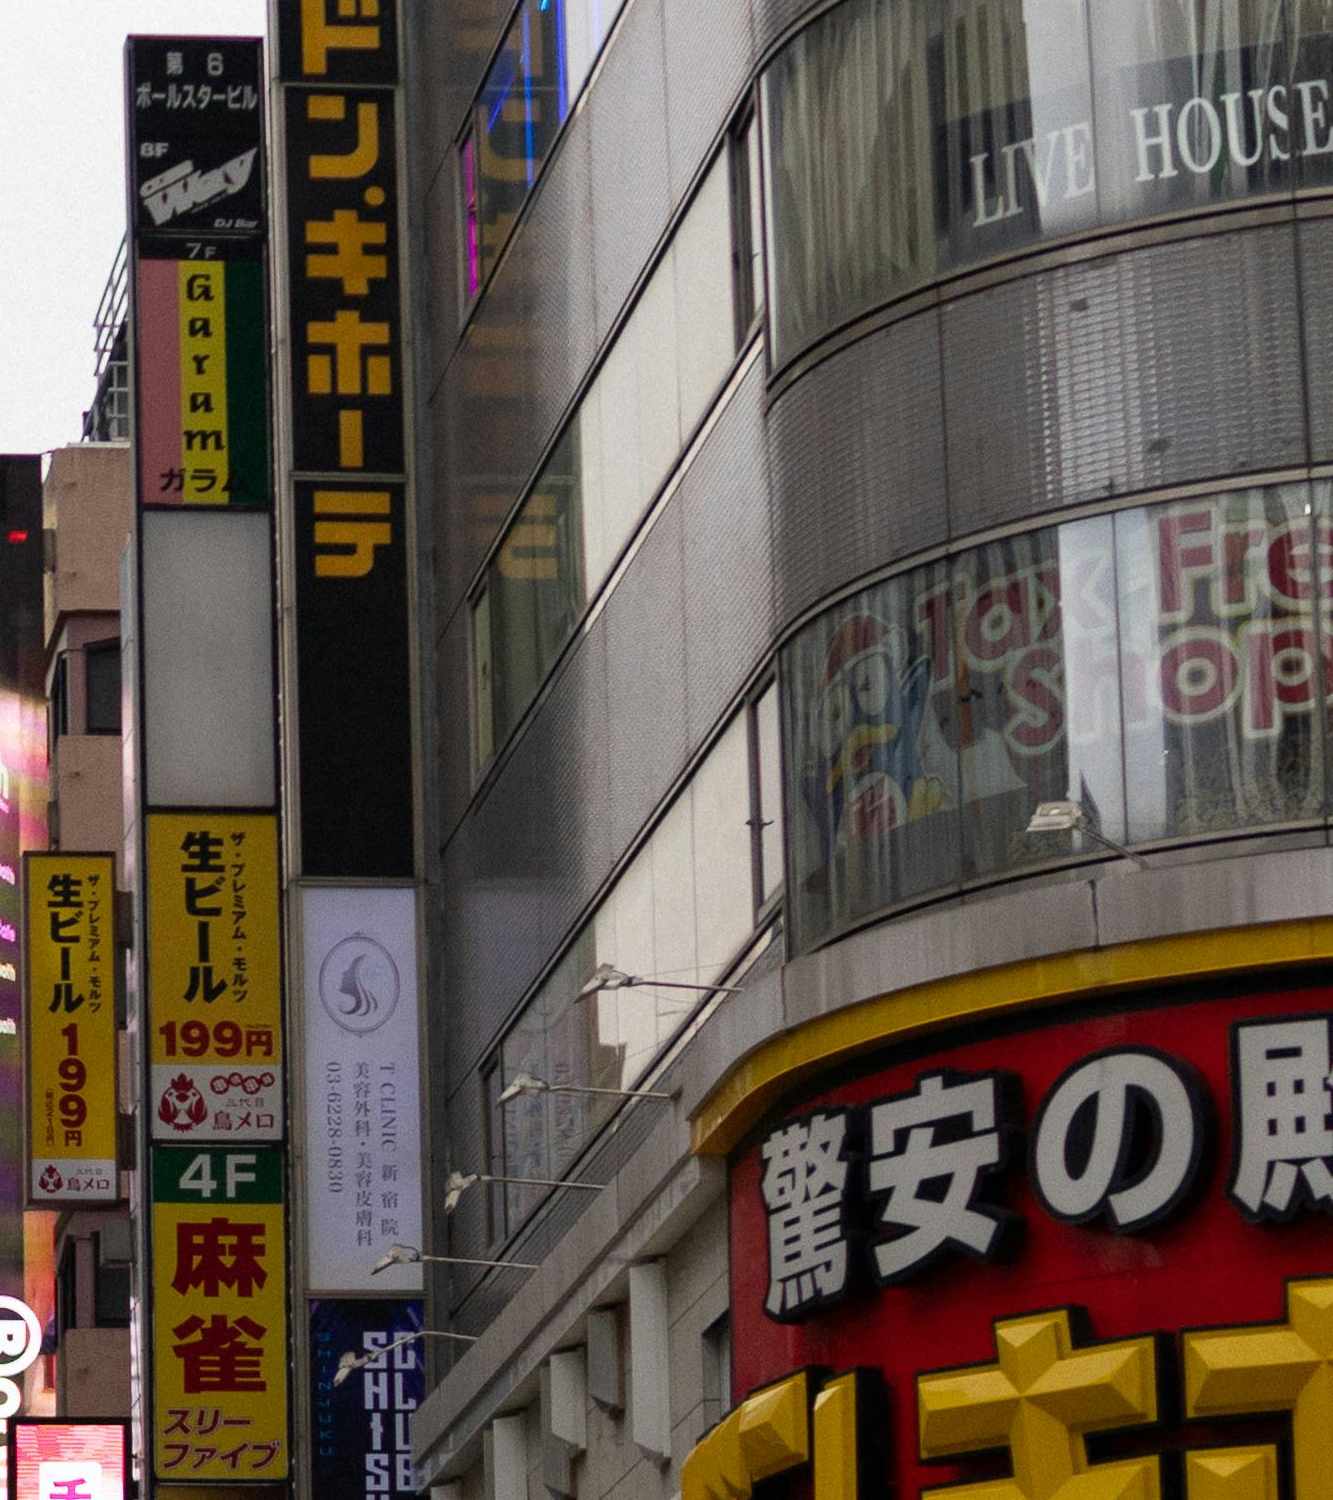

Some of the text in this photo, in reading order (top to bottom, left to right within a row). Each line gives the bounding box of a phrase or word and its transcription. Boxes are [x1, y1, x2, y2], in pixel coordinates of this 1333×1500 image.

[139, 142, 170, 157] 8F
[971, 75, 1333, 229] LIVE HOUSE
[186, 243, 216, 260] 7F
[182, 273, 227, 453] Garam
[159, 469, 250, 494] ガラム
[47, 873, 86, 1013] 生ビール
[87, 873, 102, 1014] ザ・プレミアム・モルツ
[179, 830, 229, 1005] 生ビール
[230, 831, 250, 1006] ザ・プレミアム・モルツ
[159, 1020, 274, 1058] 199円
[57, 1022, 87, 1147] 199円
[212, 1112, 275, 1131] 鳥メロ
[67, 1177, 111, 1192] 鳥メロ
[178, 1153, 257, 1199] 4F
[353, 1061, 374, 1247] 美容外科・美容皮膚科
[171, 1217, 268, 1396] 麻雀
[163, 1443, 280, 1470] ファイブ
[164, 1408, 252, 1435] スリー
